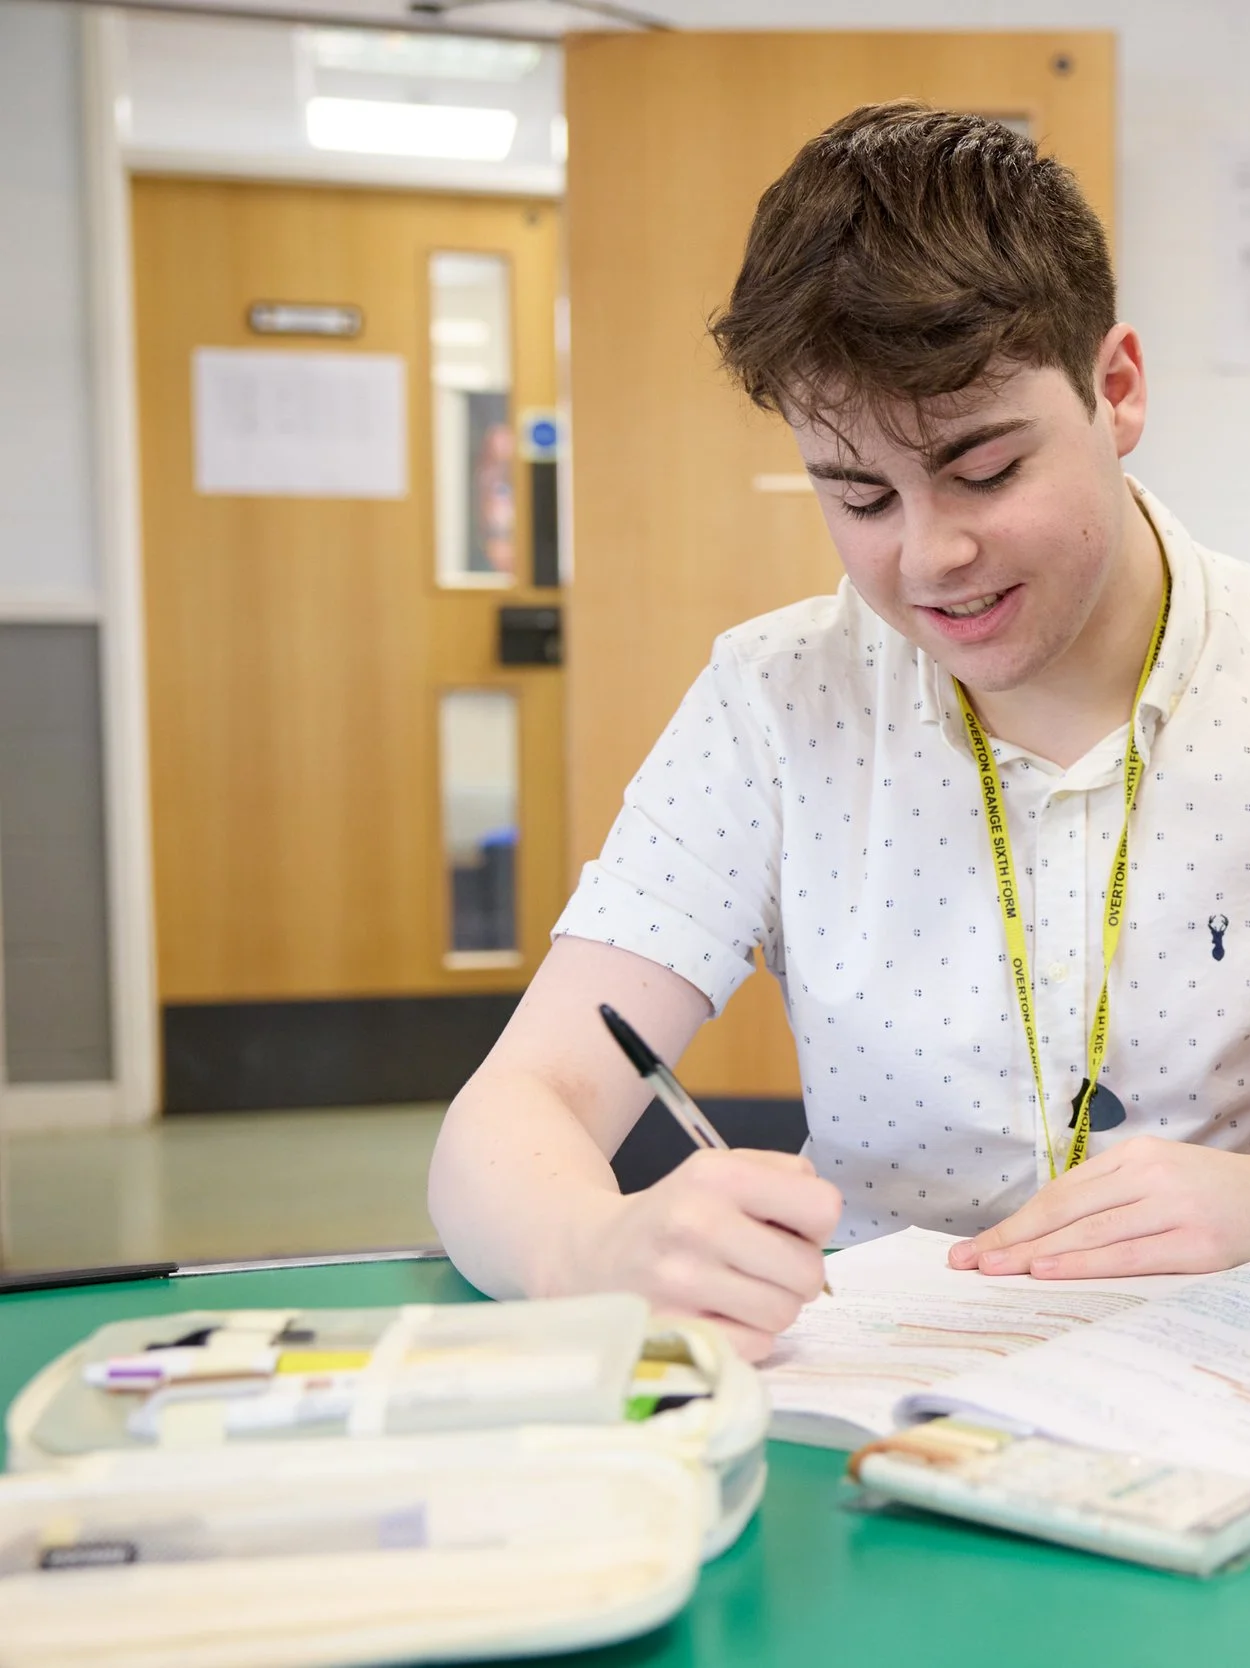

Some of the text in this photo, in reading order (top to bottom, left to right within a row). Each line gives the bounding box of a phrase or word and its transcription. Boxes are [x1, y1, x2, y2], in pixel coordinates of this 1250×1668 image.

[965, 712, 1017, 919] OVERTON GRANGE SIXTH FORM
[1108, 862, 1126, 927] OVERTON
[1013, 958, 1031, 1022] OVERTON
